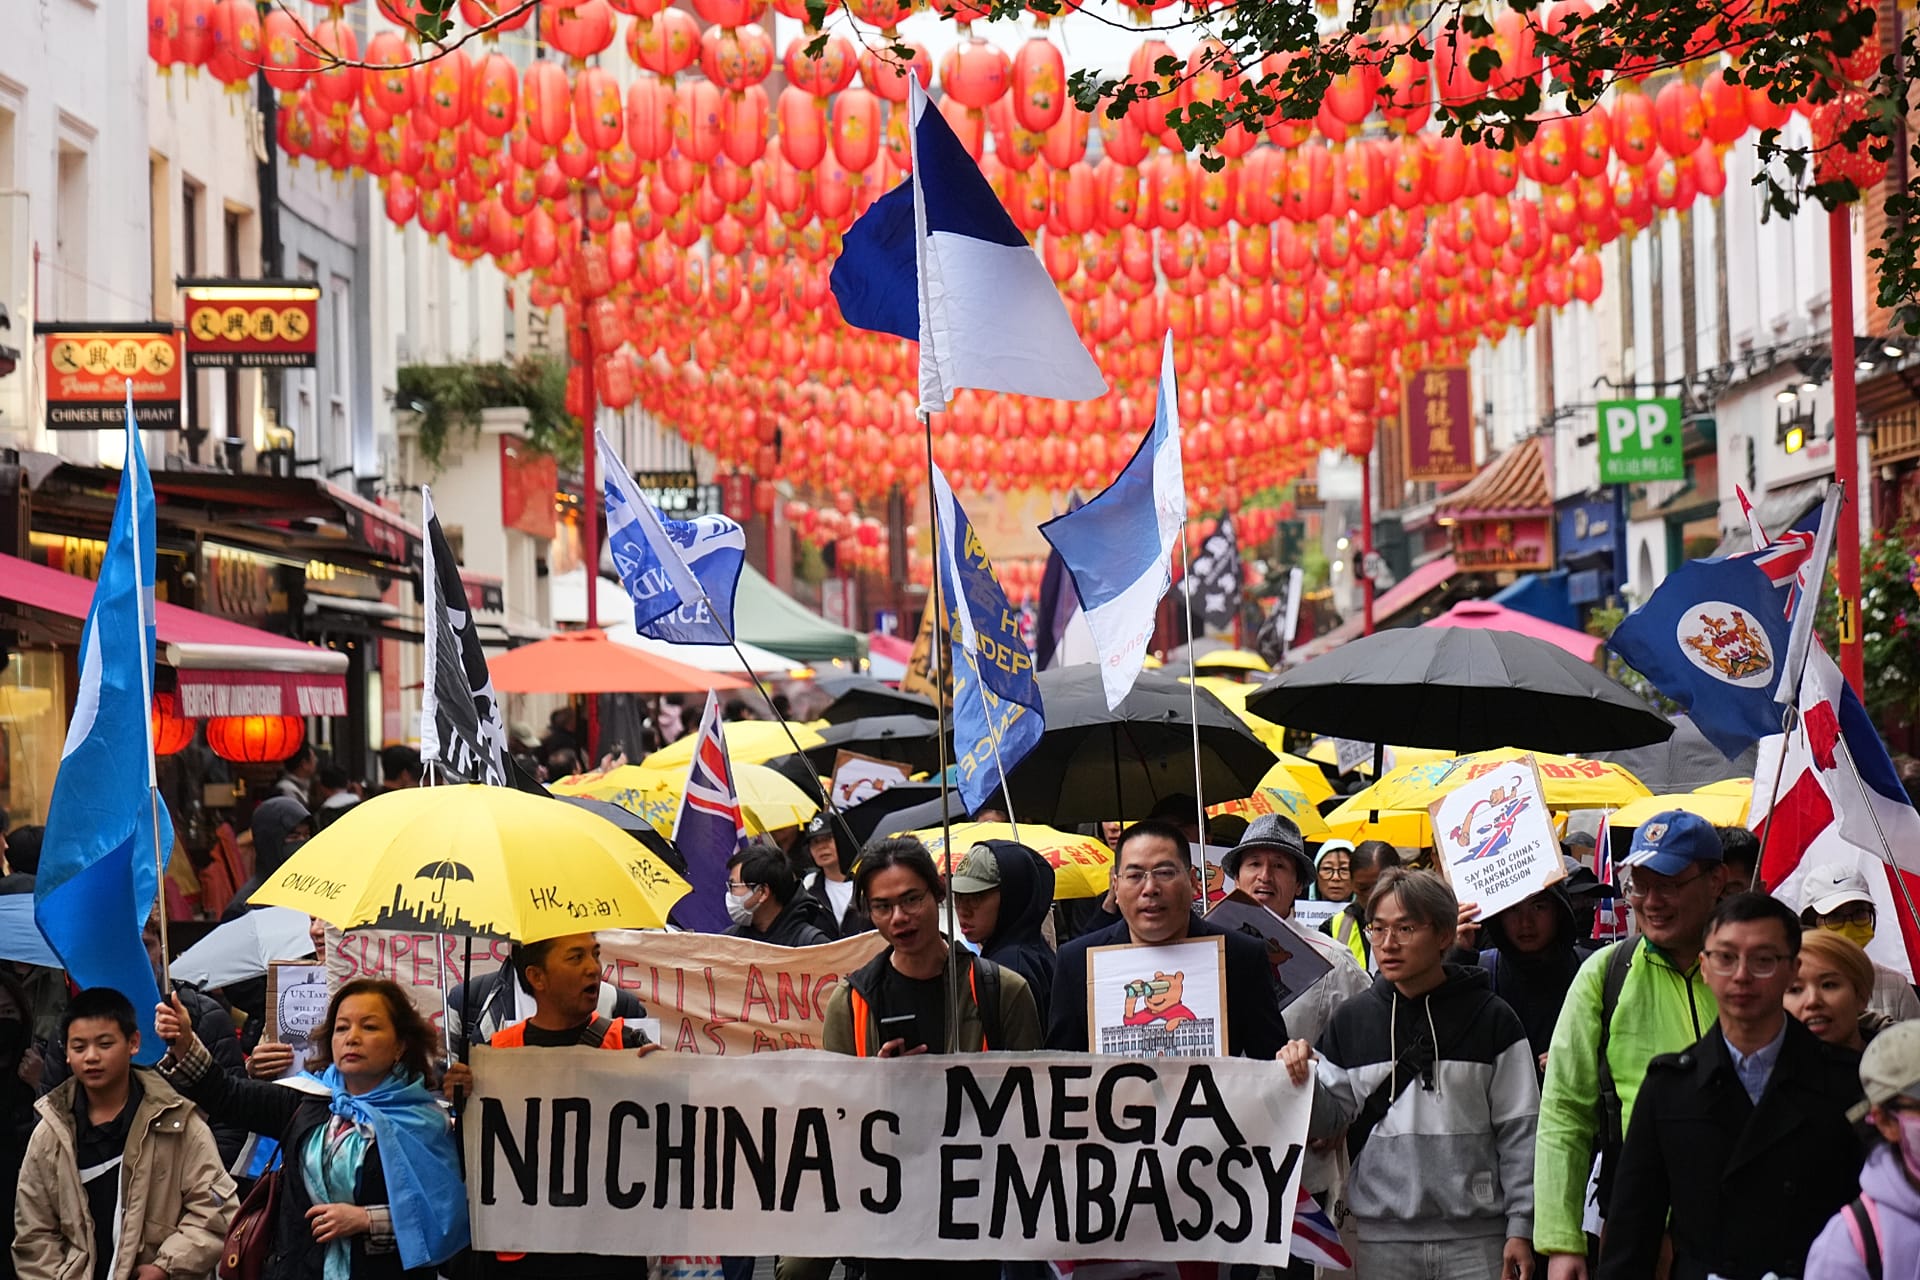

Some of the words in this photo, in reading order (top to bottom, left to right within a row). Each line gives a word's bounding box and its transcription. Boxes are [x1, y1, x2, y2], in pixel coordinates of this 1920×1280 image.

[192, 353, 234, 366] CHINESE
[241, 353, 309, 366] RESTAURANT
[51, 407, 100, 423] CHINESE
[101, 407, 175, 422] RESTURANT
[1464, 870, 1481, 885] SAY
[1482, 863, 1495, 876] NO
[1496, 858, 1507, 869] TO
[1508, 839, 1541, 862] CHINA'S
[1473, 853, 1537, 891] TRANSNATIONAL
[281, 873, 319, 891] ONLY
[314, 879, 347, 901] ONE
[530, 886, 563, 911] HK
[1484, 867, 1531, 897] REPRESSION
[941, 1062, 1247, 1146] MEGA
[479, 1096, 592, 1207] NO
[605, 1099, 901, 1214] CHINA'S
[938, 1143, 1303, 1245] EMBASSY
